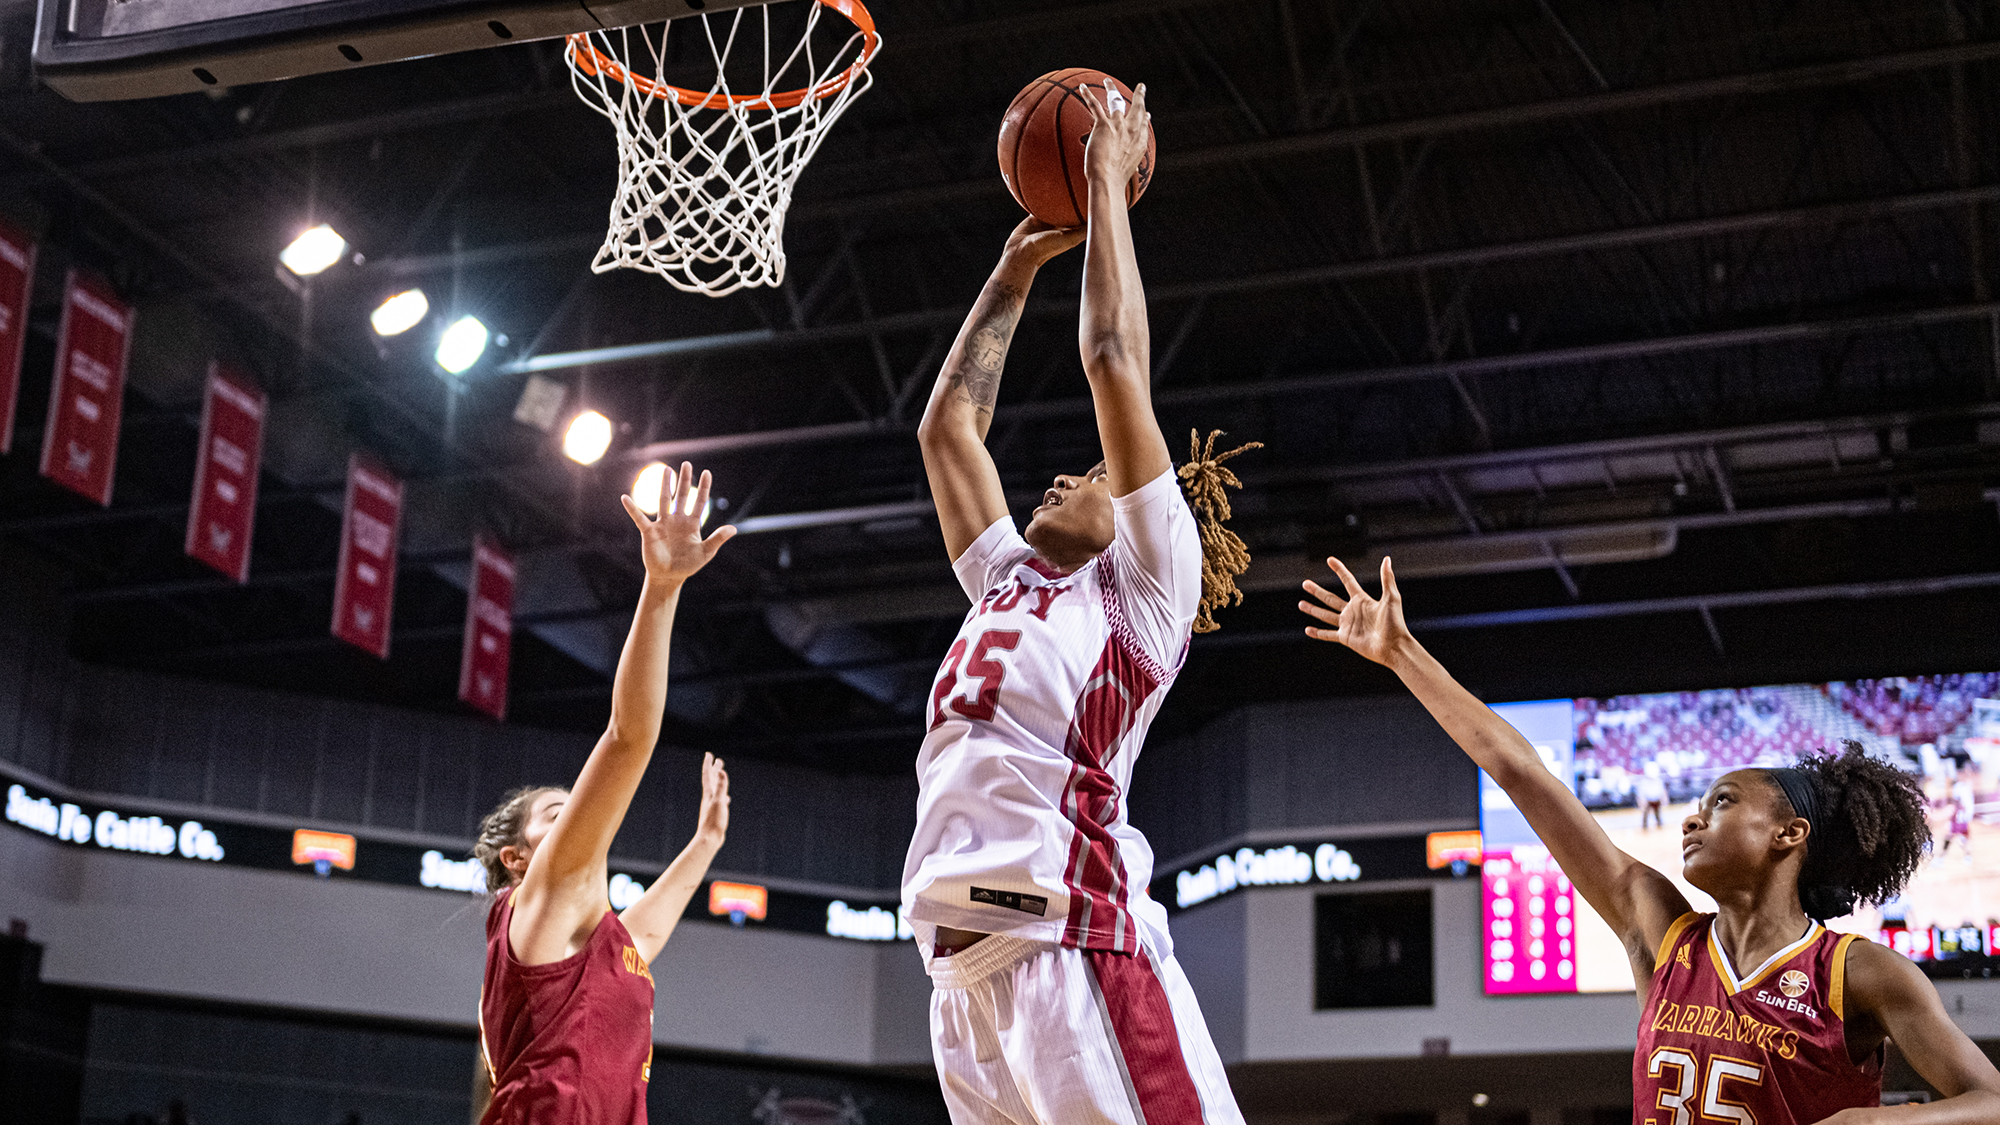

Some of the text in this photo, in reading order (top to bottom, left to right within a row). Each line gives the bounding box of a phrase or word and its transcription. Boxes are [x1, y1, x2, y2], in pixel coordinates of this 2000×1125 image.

[6, 784, 59, 836] Santa
[95, 811, 176, 855] Cattle
[178, 821, 225, 861] Co.
[1315, 843, 1361, 881] Co.
[1647, 1046, 1765, 1125] 35
